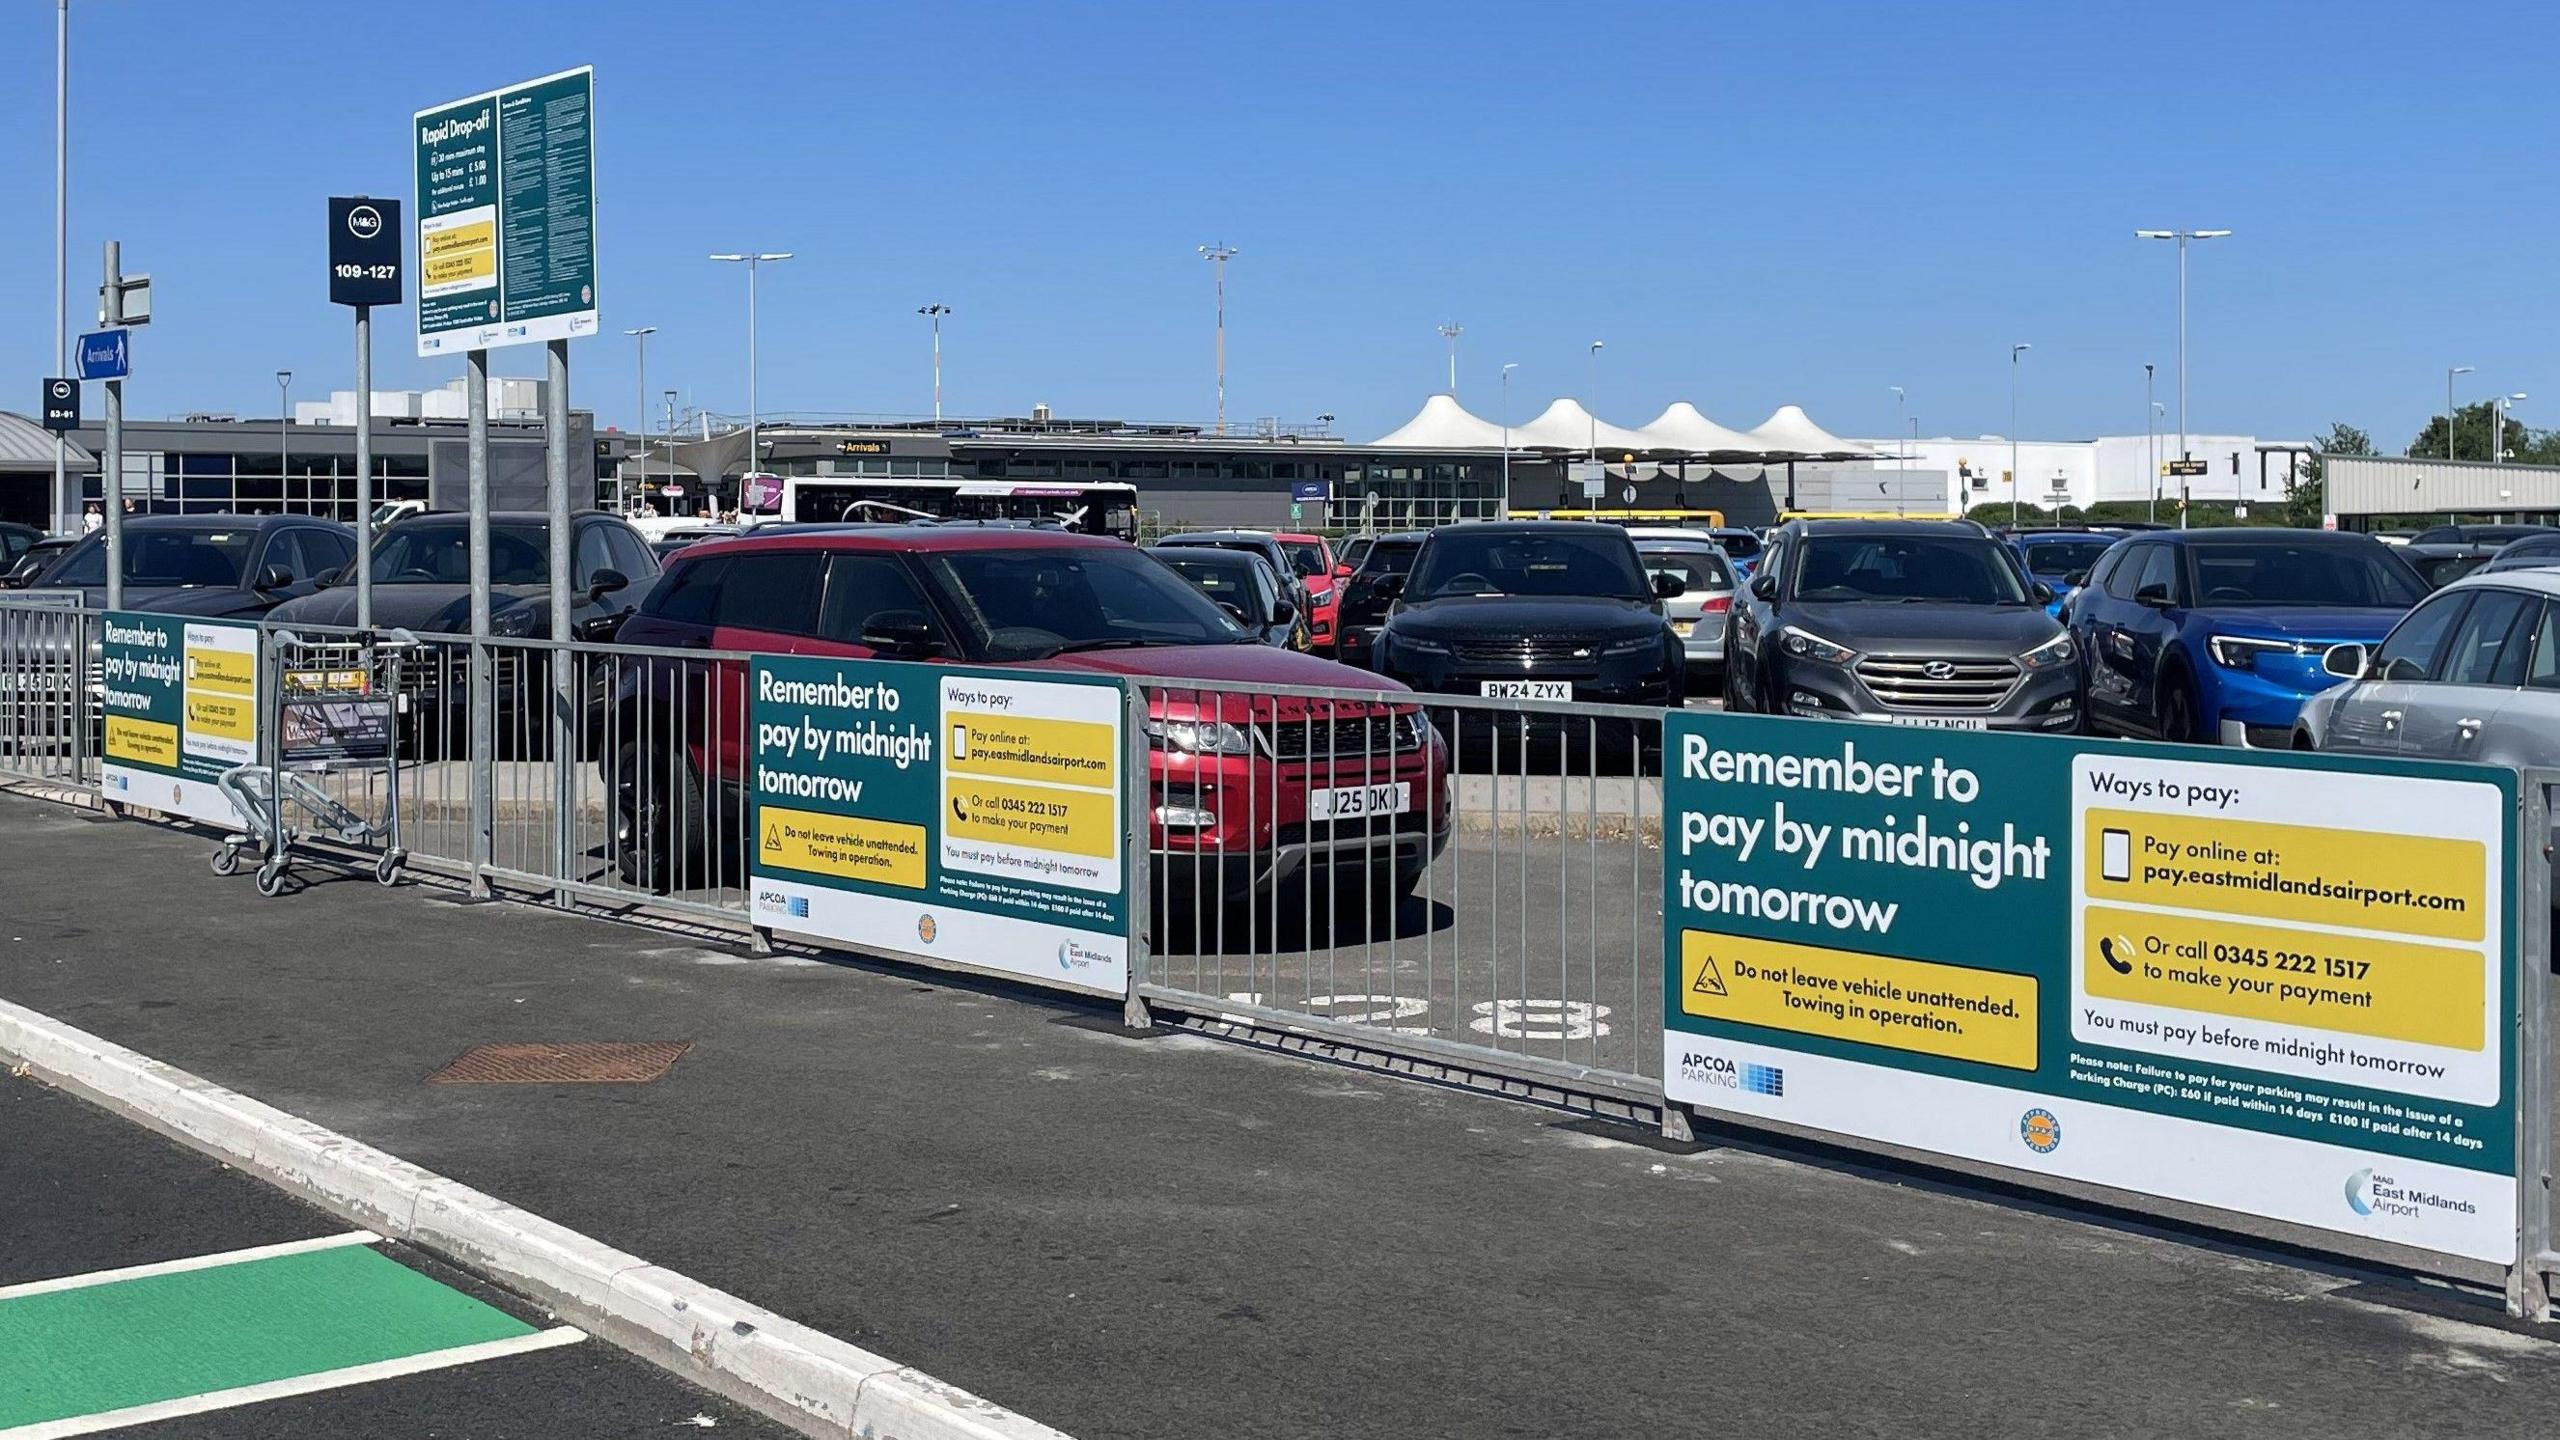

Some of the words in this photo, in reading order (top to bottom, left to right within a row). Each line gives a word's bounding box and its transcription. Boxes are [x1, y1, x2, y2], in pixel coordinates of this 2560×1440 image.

[422, 120, 448, 147] Rapid
[450, 108, 490, 139] Drop-off
[431, 172, 438, 183] Up
[439, 171, 445, 180] to
[445, 168, 451, 178] 15
[452, 167, 464, 177] mins
[474, 160, 487, 171] 5.00
[474, 174, 487, 186] 1.00
[352, 217, 377, 228] M&G
[335, 264, 396, 279] 109-127
[86, 345, 114, 362] Arrivals
[846, 443, 880, 452] Arrivals
[105, 619, 156, 647] Remember
[157, 627, 167, 648] to
[105, 657, 124, 680] pay
[125, 650, 138, 682] by
[139, 654, 180, 687] midnight
[105, 685, 151, 710] tomorrow
[760, 670, 874, 709] Remember
[877, 681, 900, 712] to
[948, 687, 975, 706] Ways
[977, 691, 987, 704] to
[990, 695, 1013, 709] pay:
[1489, 683, 1529, 698] BW24
[1534, 683, 1564, 698] ZYX
[759, 723, 800, 758] pay
[804, 714, 832, 761] by
[836, 720, 932, 770] midnight
[971, 729, 987, 744] Pay
[990, 729, 1016, 744] online
[1018, 734, 1030, 745] at:
[971, 748, 1106, 770] pay.eastmidlandsairport.com
[1683, 734, 1923, 797] Remember
[1931, 758, 1980, 803] to
[758, 764, 863, 802] tomorrow
[2089, 771, 2152, 801] Ways
[2158, 779, 2180, 799] to
[2188, 784, 2239, 809] pay:
[972, 794, 983, 807] Or
[985, 797, 999, 809] call
[1001, 798, 1025, 812] 0345
[1027, 801, 1045, 815] 222
[1048, 804, 1068, 817] 1517
[972, 813, 980, 823] to
[982, 813, 1006, 826] make
[1007, 819, 1027, 831] your
[1030, 822, 1069, 836] payment
[784, 825, 795, 838] Do
[797, 829, 811, 840] not
[812, 828, 835, 843] leave
[836, 832, 864, 847] vehicle
[866, 840, 918, 855] unattended.
[1682, 811, 1765, 862] pay
[1775, 801, 1832, 869] by
[1842, 814, 2050, 890] midnight
[2144, 835, 2180, 861] Pay
[2186, 840, 2247, 863] online
[2254, 846, 2280, 866] at:
[808, 844, 837, 862] Towing
[839, 850, 847, 861] in
[848, 853, 893, 868] operation.
[946, 844, 960, 858] You
[961, 849, 979, 860] must
[980, 853, 995, 866] pay
[996, 852, 1022, 867] before
[1023, 857, 1058, 874] midnight
[1060, 862, 1099, 878] tomorrow
[759, 891, 786, 904] APCOA
[1680, 869, 1898, 933] tomorrow
[2144, 866, 2465, 911] pay.eastmidlandsairport.com
[2145, 936, 2169, 954] Or
[2175, 940, 2207, 960] call
[2214, 944, 2268, 968] 0345
[2274, 951, 2316, 974] 222
[2324, 957, 2371, 980] 1517
[1734, 960, 1756, 978] Do
[1761, 967, 1788, 983] not
[1791, 966, 1838, 991] leave
[1842, 977, 1901, 1001] vehicle
[1907, 989, 2019, 1019] unattended.
[2144, 962, 2161, 979] to
[2169, 966, 2221, 987] make
[2228, 976, 2274, 994] your
[2280, 983, 2372, 1007] payment
[1783, 990, 1845, 1020] Towing
[1849, 999, 1864, 1019] in
[1869, 1008, 1963, 1035] operation.
[2084, 1008, 2114, 1028] You
[2120, 1018, 2158, 1036] must
[2164, 1027, 2197, 1045] pay
[2202, 1025, 2259, 1050] before
[2265, 1037, 2345, 1066] midnight
[2350, 1050, 2445, 1078] tomorrow
[1681, 1067, 1737, 1089] PARKING
[1682, 1052, 1736, 1075] APCOA
[2070, 1053, 2103, 1069] Please
[2106, 1059, 2133, 1073] note:
[2136, 1063, 2171, 1079] Failure
[2174, 1070, 2185, 1082] to
[2188, 1073, 2208, 1087] pay
[2211, 1074, 2227, 1088] for
[2229, 1081, 2254, 1095] your
[2257, 1084, 2302, 1102] parking
[2305, 1093, 2329, 1106] may
[2332, 1096, 2366, 1111] result
[2368, 1101, 2380, 1113] in
[2383, 1104, 2403, 1117] the
[2406, 1107, 2436, 1122] issue
[2439, 1114, 2452, 1125] of
[2454, 1118, 2463, 1127] a
[2070, 1070, 2110, 1087] Parking
[2113, 1076, 2151, 1093] Charge
[2154, 1083, 2178, 1097] (PC):
[2181, 1087, 2201, 1100] £60
[2204, 1090, 2212, 1102] if
[2214, 1092, 2239, 1109] paid
[2242, 1096, 2276, 1114] within
[2280, 1104, 2293, 1117] 14
[2296, 1106, 2323, 1122] days
[2329, 1113, 2358, 1128] £100
[2361, 1117, 2370, 1129] if
[2373, 1121, 2400, 1134] paid
[2403, 1126, 2433, 1141] after
[2435, 1130, 2451, 1143] 14
[2453, 1133, 2483, 1150] days
[2372, 1174, 2394, 1186] MAG
[2372, 1184, 2405, 1201] East
[2409, 1189, 2476, 1215] Midlands
[2372, 1198, 2420, 1218] Airport
